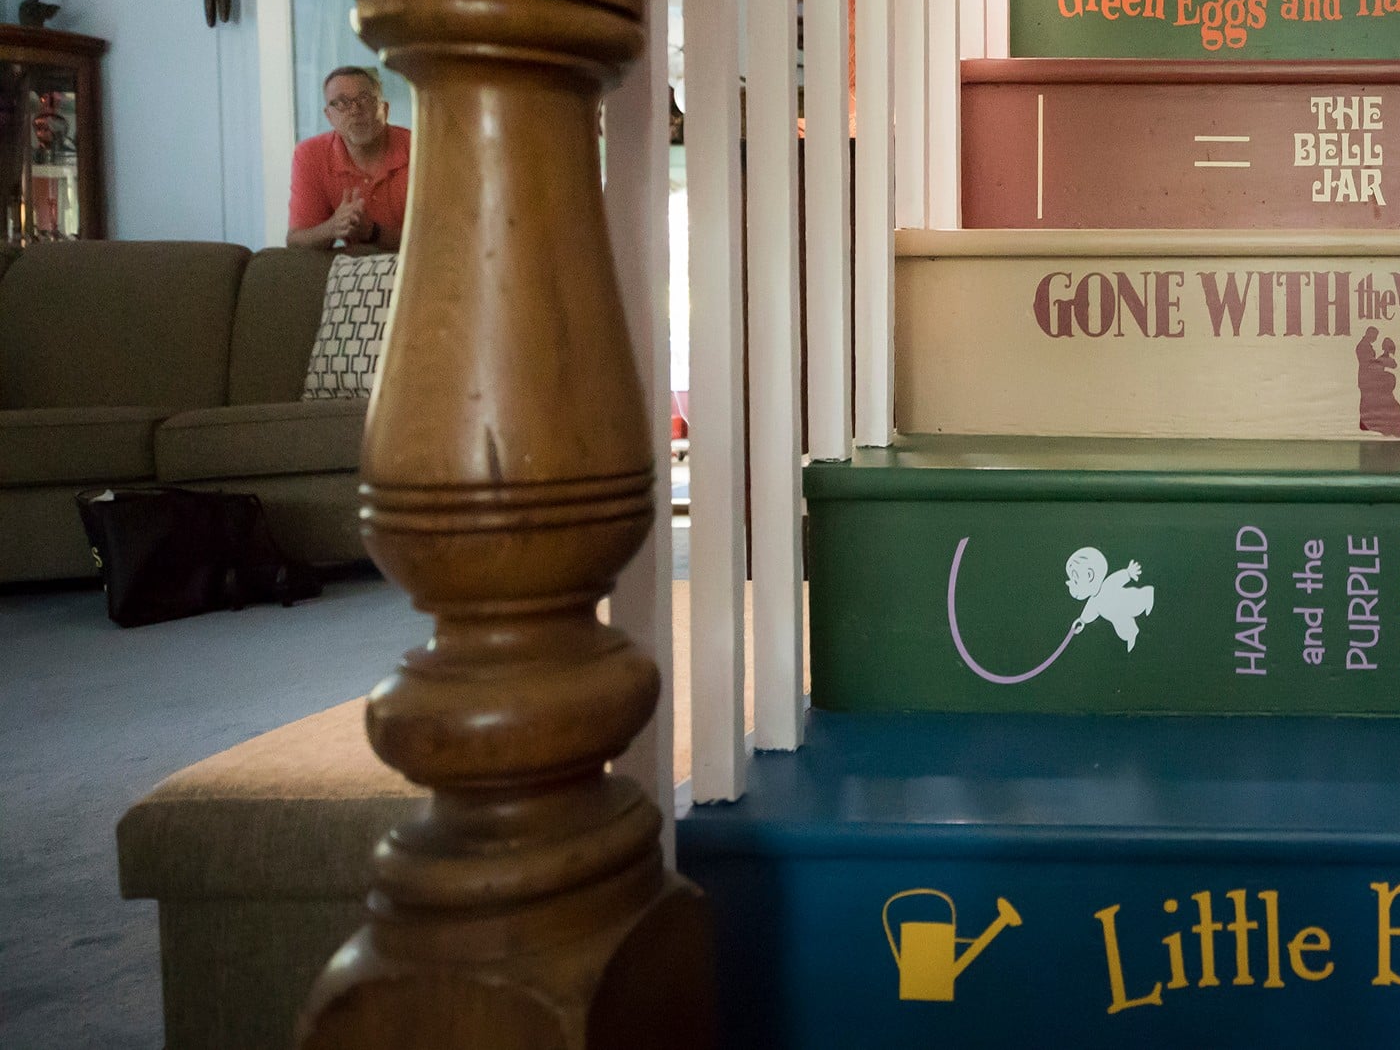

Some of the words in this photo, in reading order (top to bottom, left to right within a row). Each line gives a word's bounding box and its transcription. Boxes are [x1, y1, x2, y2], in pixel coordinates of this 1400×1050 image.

[1311, 97, 1383, 129] THE
[1294, 133, 1382, 166] BELL
[1313, 169, 1386, 205] JAR
[1033, 272, 1184, 338] GONE
[1196, 271, 1351, 337] WITH
[1354, 272, 1396, 320] the
[1293, 539, 1325, 594] the
[1235, 526, 1268, 674] HAROLD
[1346, 535, 1380, 669] PURPLE
[1293, 607, 1325, 665] and
[1094, 889, 1334, 1014] Little
